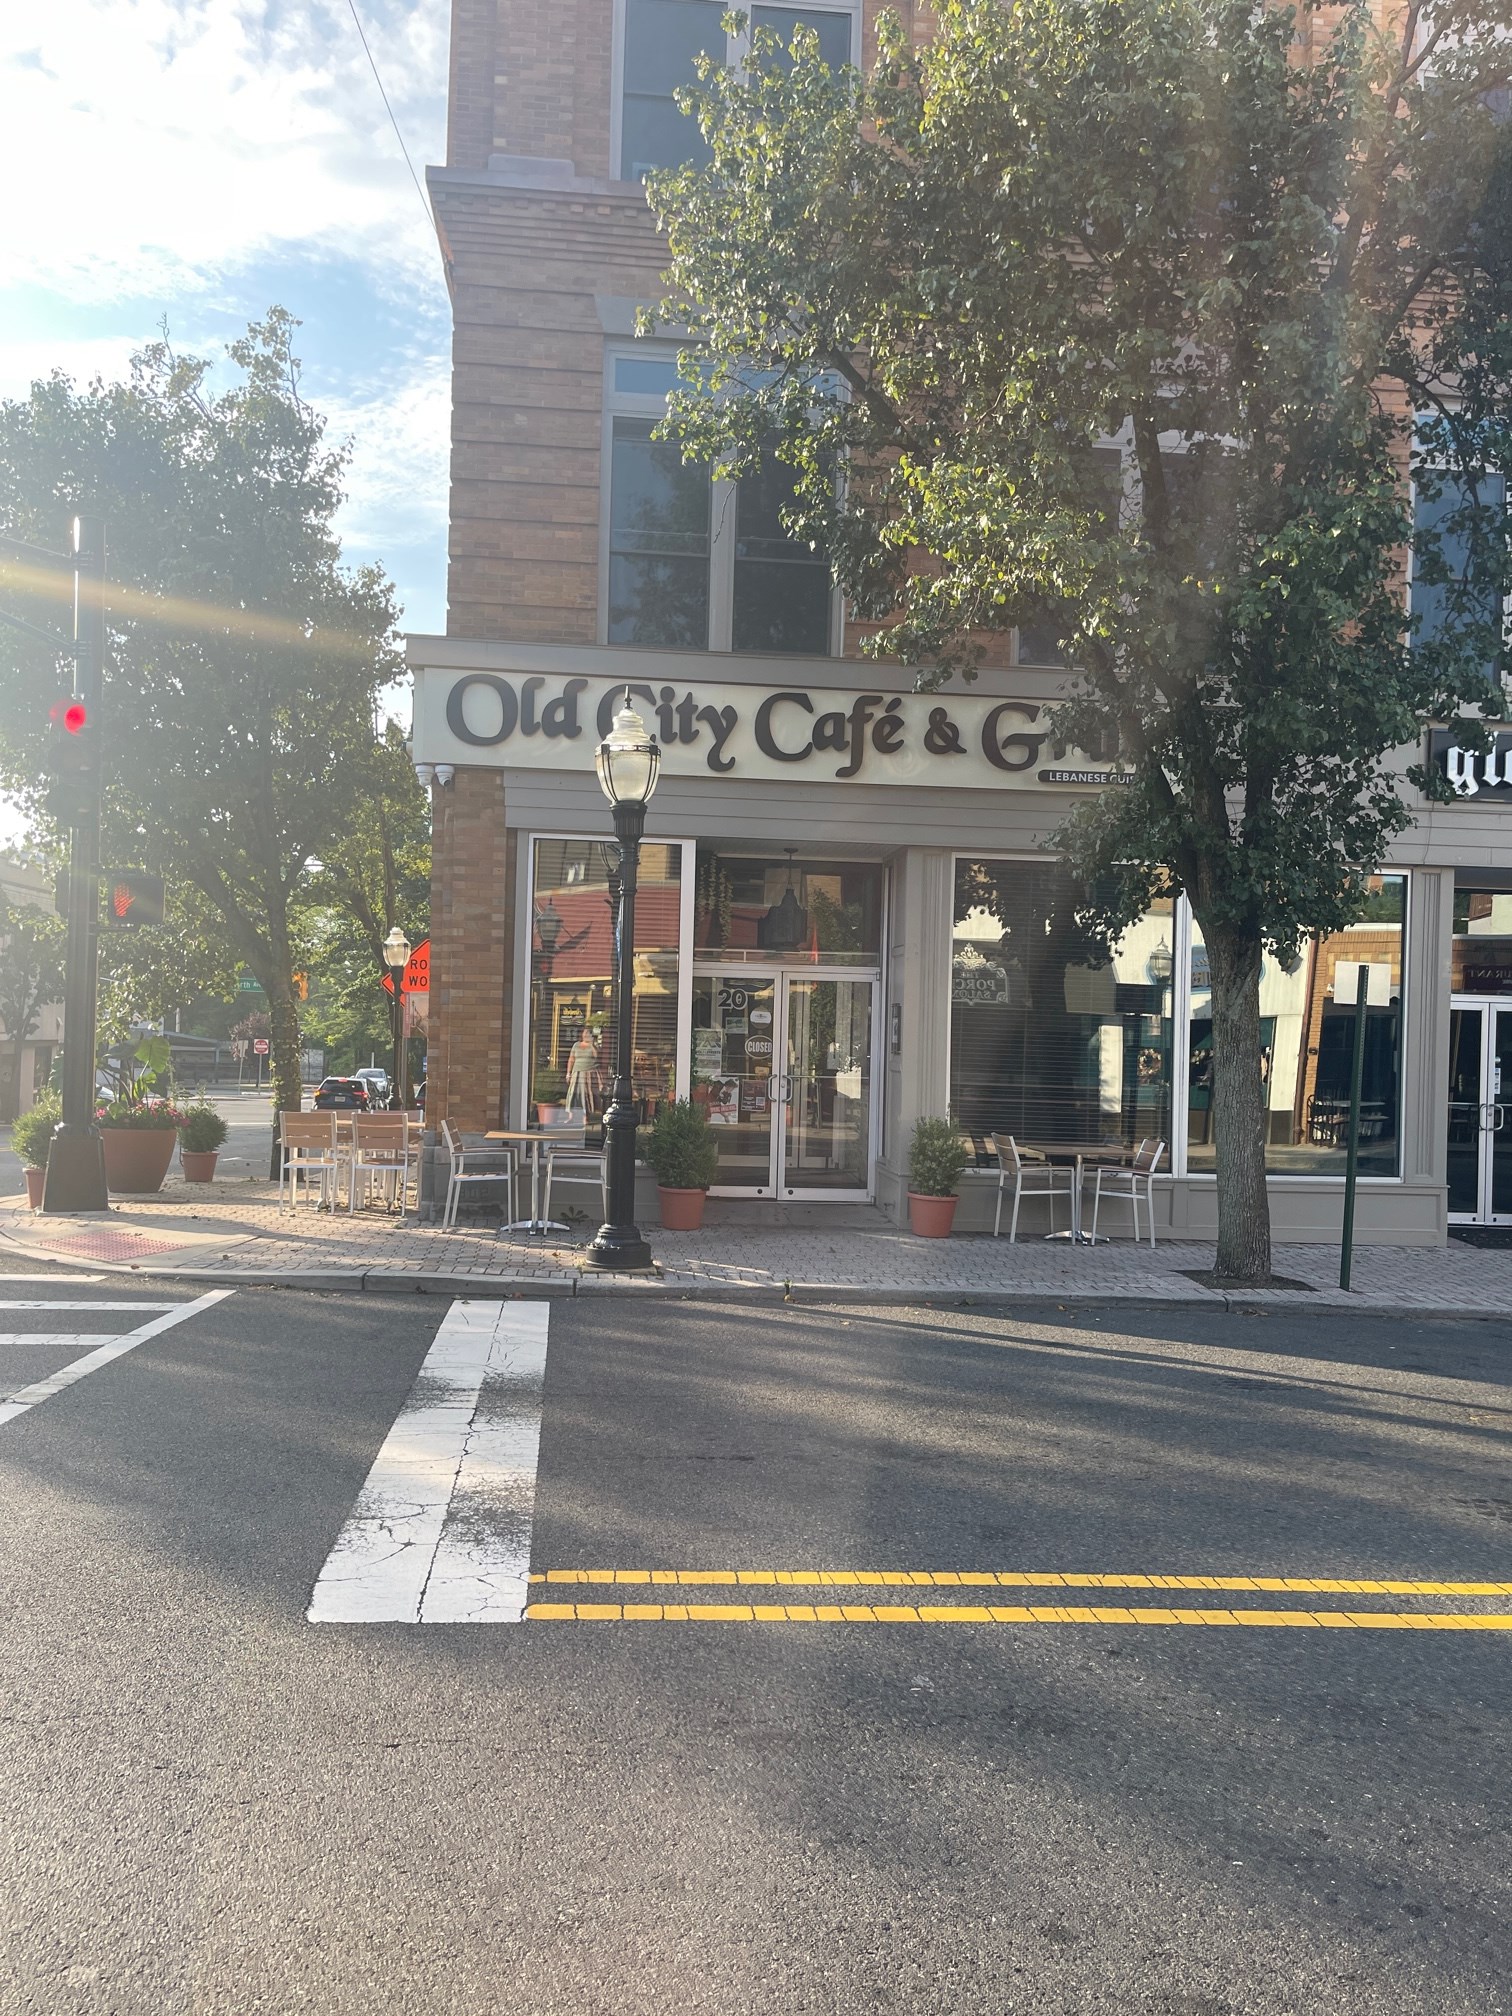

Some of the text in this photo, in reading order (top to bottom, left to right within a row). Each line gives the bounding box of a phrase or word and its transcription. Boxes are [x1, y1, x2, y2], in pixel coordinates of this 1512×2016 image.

[446, 673, 589, 746] Old
[597, 684, 738, 772] City
[755, 691, 904, 778] Café
[923, 706, 967, 755] &
[1049, 771, 1107, 784] LEBANESE
[718, 988, 748, 1010] 20
[747, 1040, 773, 1054] CLOSED
